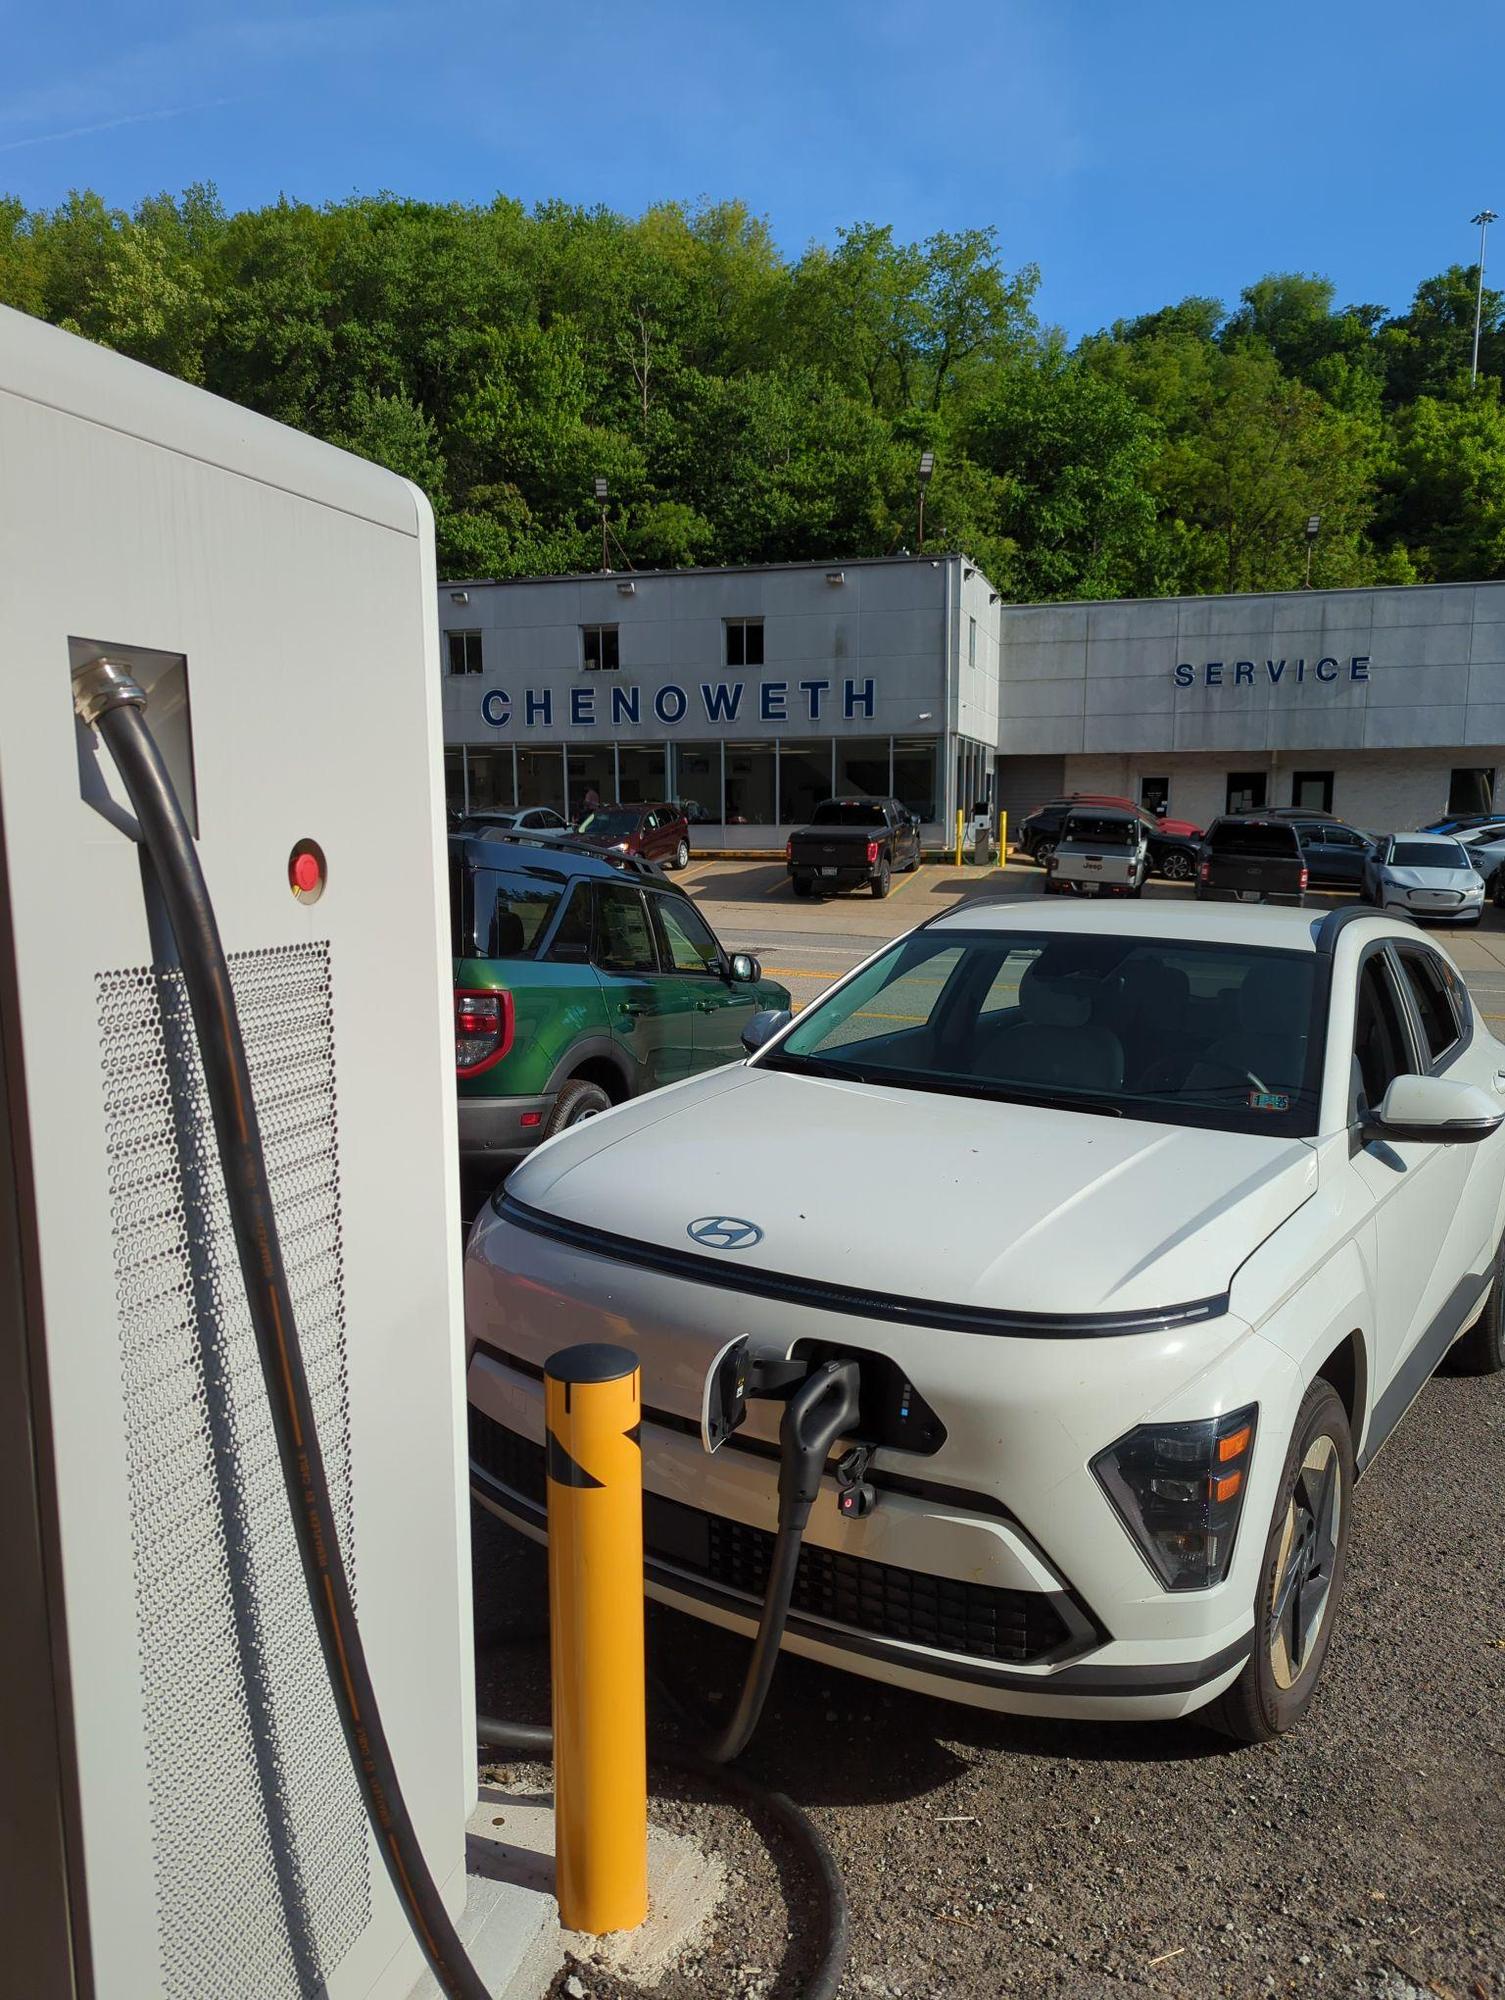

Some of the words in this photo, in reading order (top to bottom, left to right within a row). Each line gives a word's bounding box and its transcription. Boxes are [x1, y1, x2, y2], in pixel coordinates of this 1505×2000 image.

[1175, 656, 1371, 688] SERVICE
[480, 678, 876, 728] CHENOWETH
[1082, 862, 1103, 871] Jeep
